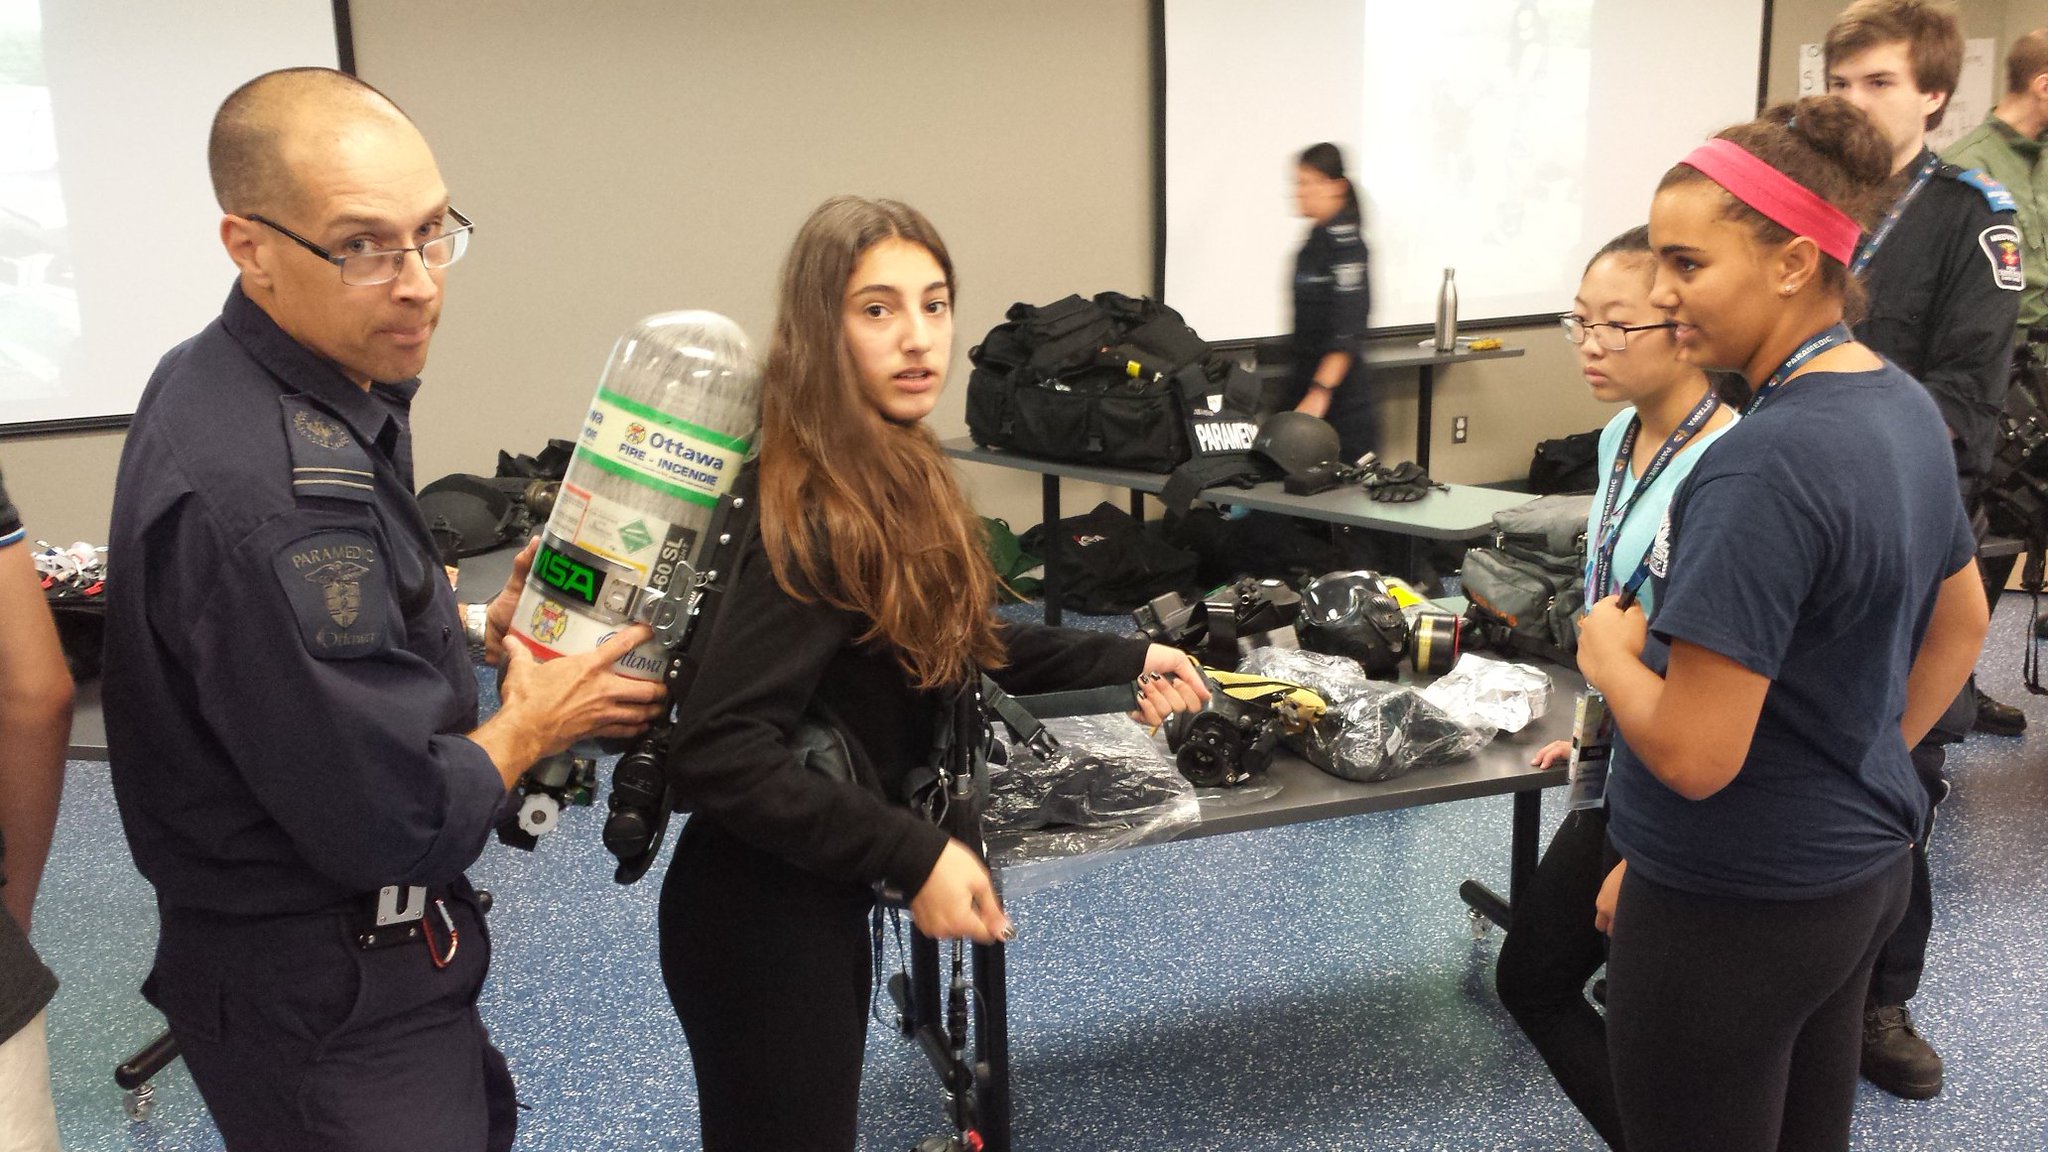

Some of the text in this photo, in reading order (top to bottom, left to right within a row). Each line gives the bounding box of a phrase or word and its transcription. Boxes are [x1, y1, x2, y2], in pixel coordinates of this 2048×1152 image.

[1785, 335, 1834, 369] PARAMEDIC
[1687, 398, 1714, 428] OTTAWA
[618, 442, 647, 461] FIRE
[657, 458, 718, 486] INCENDIE
[649, 432, 724, 471] Ottawa
[1641, 446, 1673, 489] PARAMEDIC
[291, 545, 375, 569] PARAMEDIC
[662, 537, 684, 562] SL
[316, 631, 375, 650] Ottawa
[620, 649, 663, 674] ttawa
